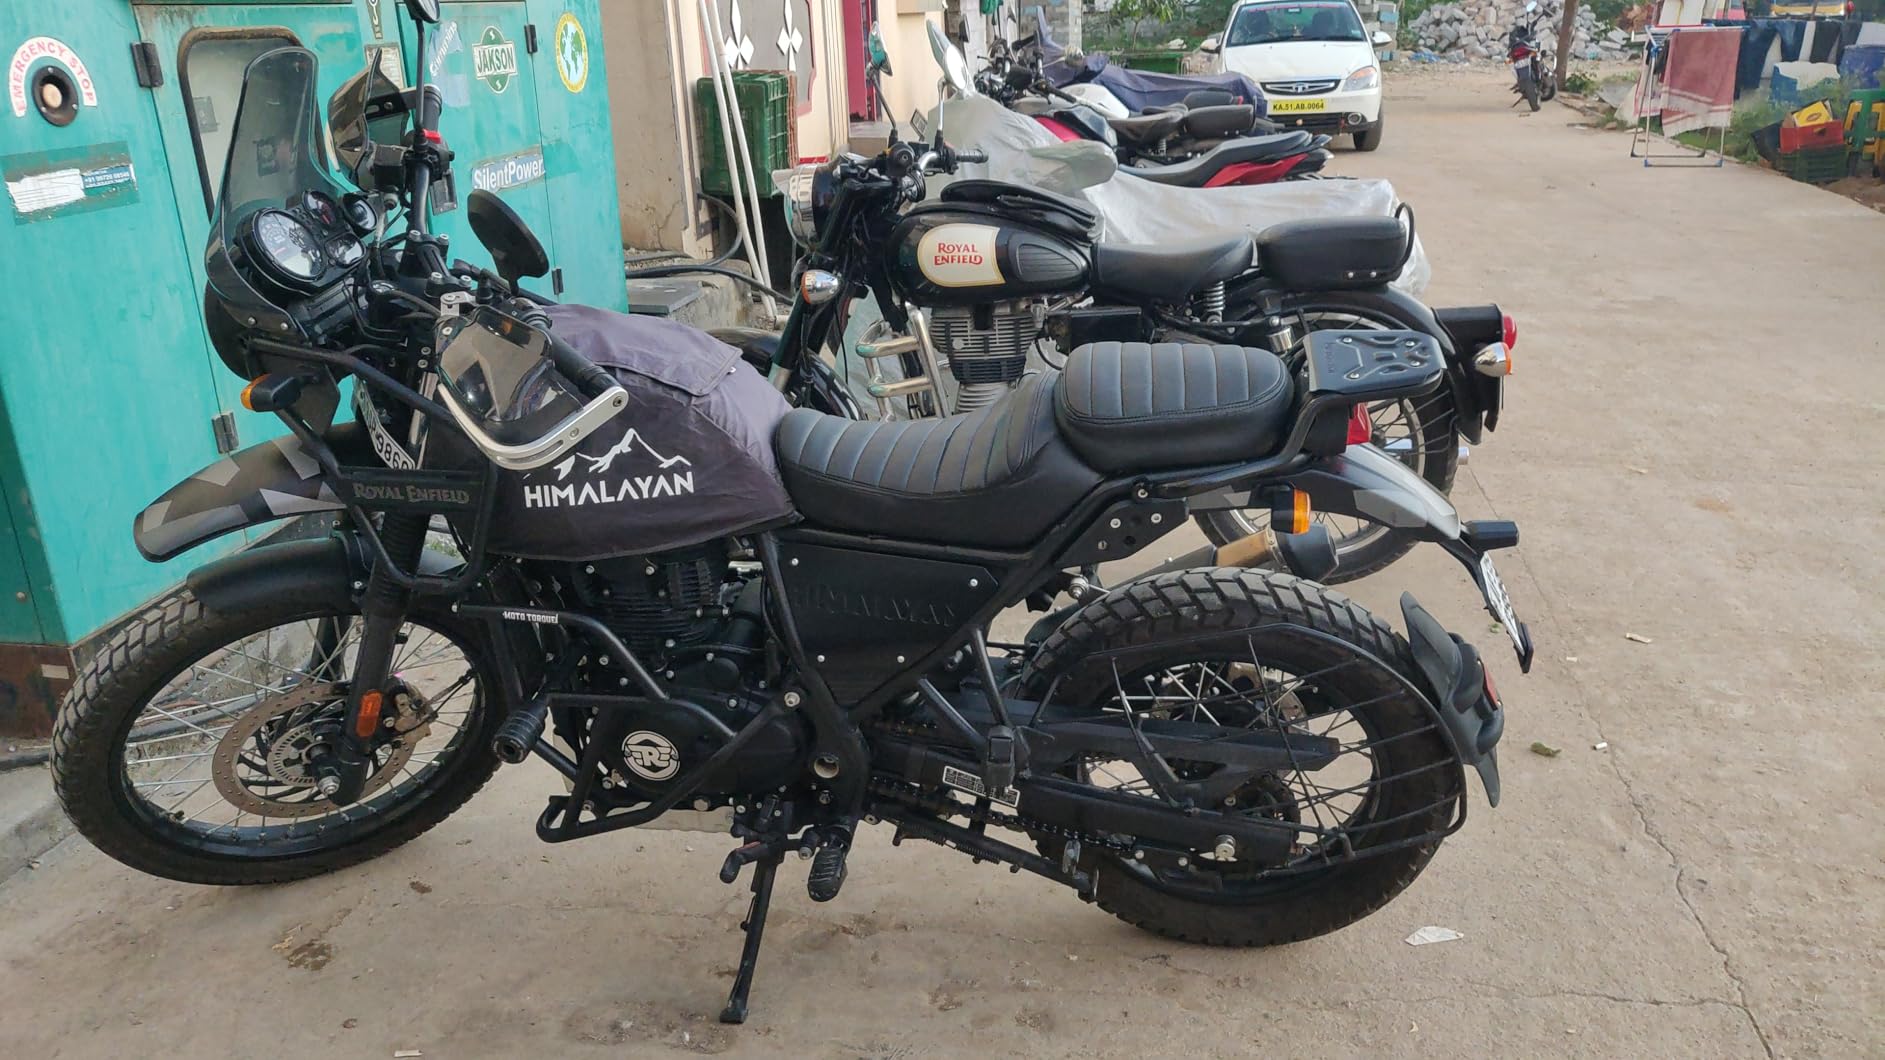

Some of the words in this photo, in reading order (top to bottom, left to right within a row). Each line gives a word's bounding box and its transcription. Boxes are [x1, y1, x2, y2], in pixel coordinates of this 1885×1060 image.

[477, 47, 515, 74] JAKSON
[13, 41, 66, 111] EMERGENCY
[69, 57, 94, 102] STOP
[474, 159, 544, 191] SilentPower
[934, 254, 983, 266] ENFIELD
[937, 242, 978, 254] ROYAL
[353, 483, 405, 500] ROYAL
[406, 485, 470, 504] ENFIELD
[524, 471, 695, 508] HIMALAYAN
[503, 611, 526, 621] MOTO
[526, 613, 558, 624] TORQUE
